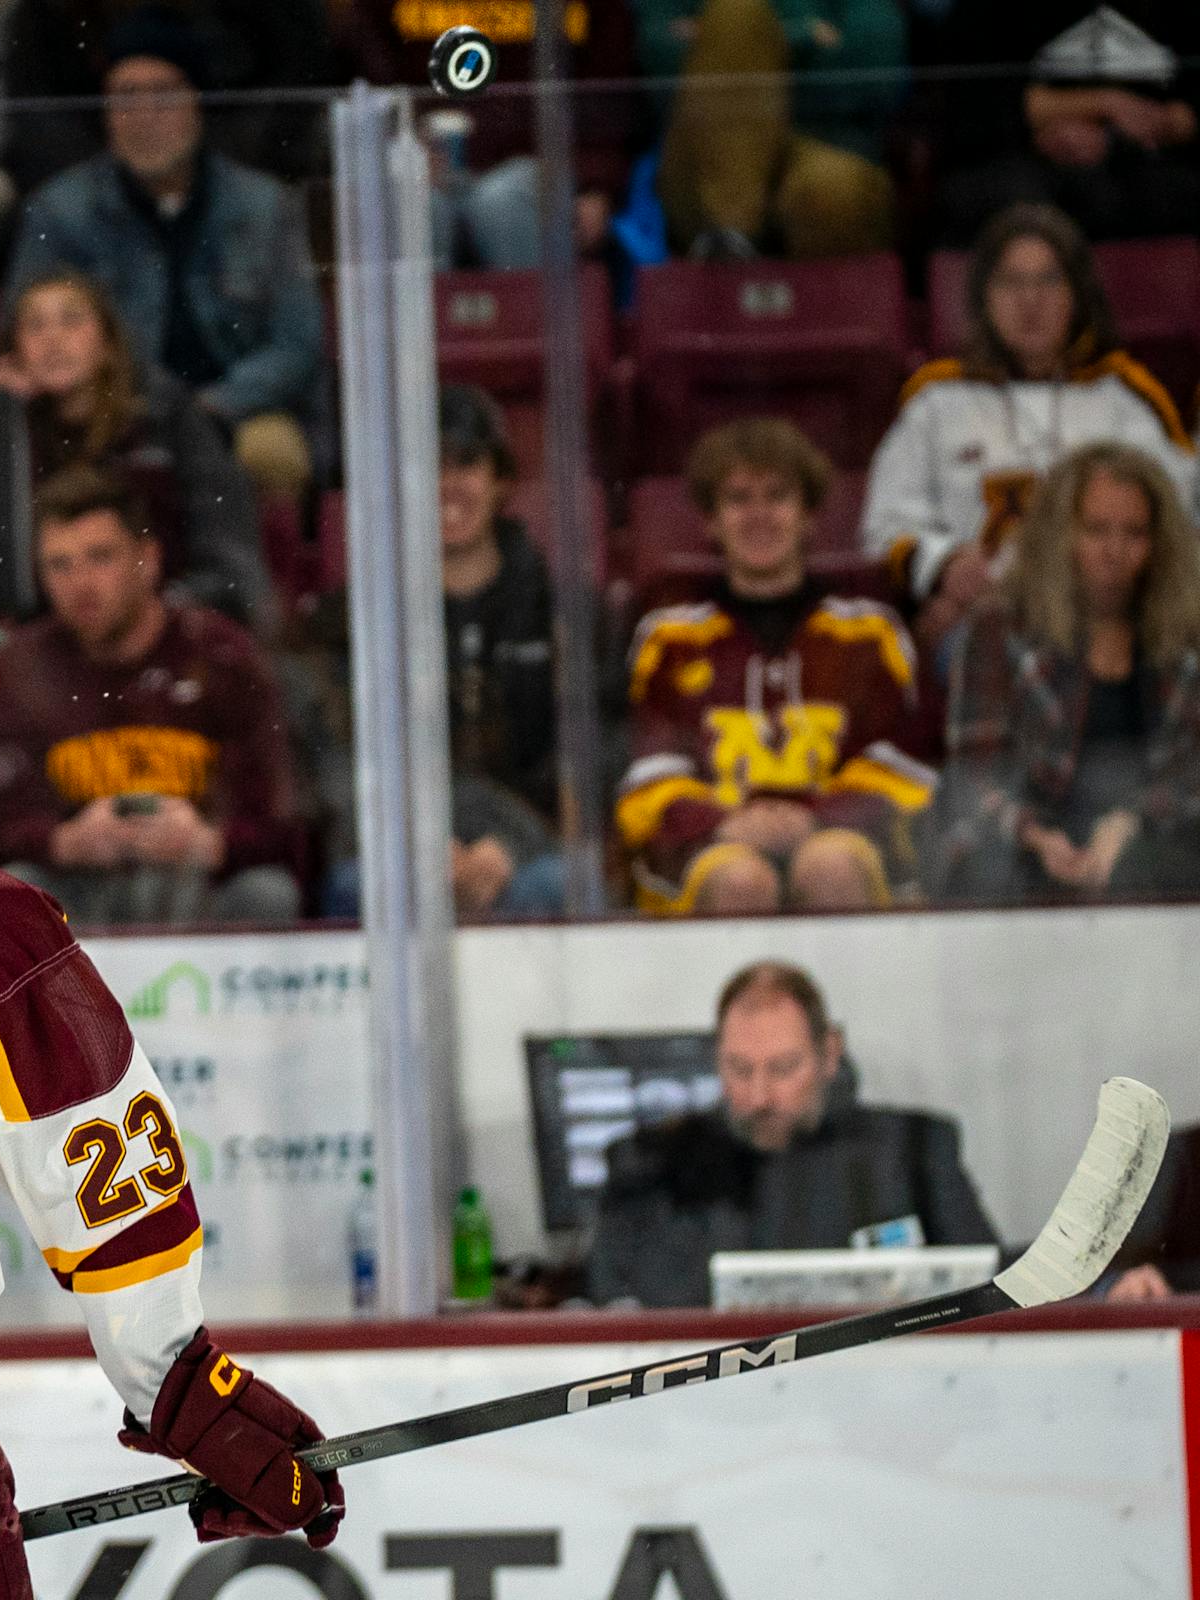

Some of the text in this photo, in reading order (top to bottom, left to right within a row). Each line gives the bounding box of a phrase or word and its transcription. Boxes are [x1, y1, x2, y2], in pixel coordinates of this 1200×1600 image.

[63, 1090, 187, 1230] 23
[567, 1334, 798, 1413] CCM
[291, 1459, 301, 1506] CCM
